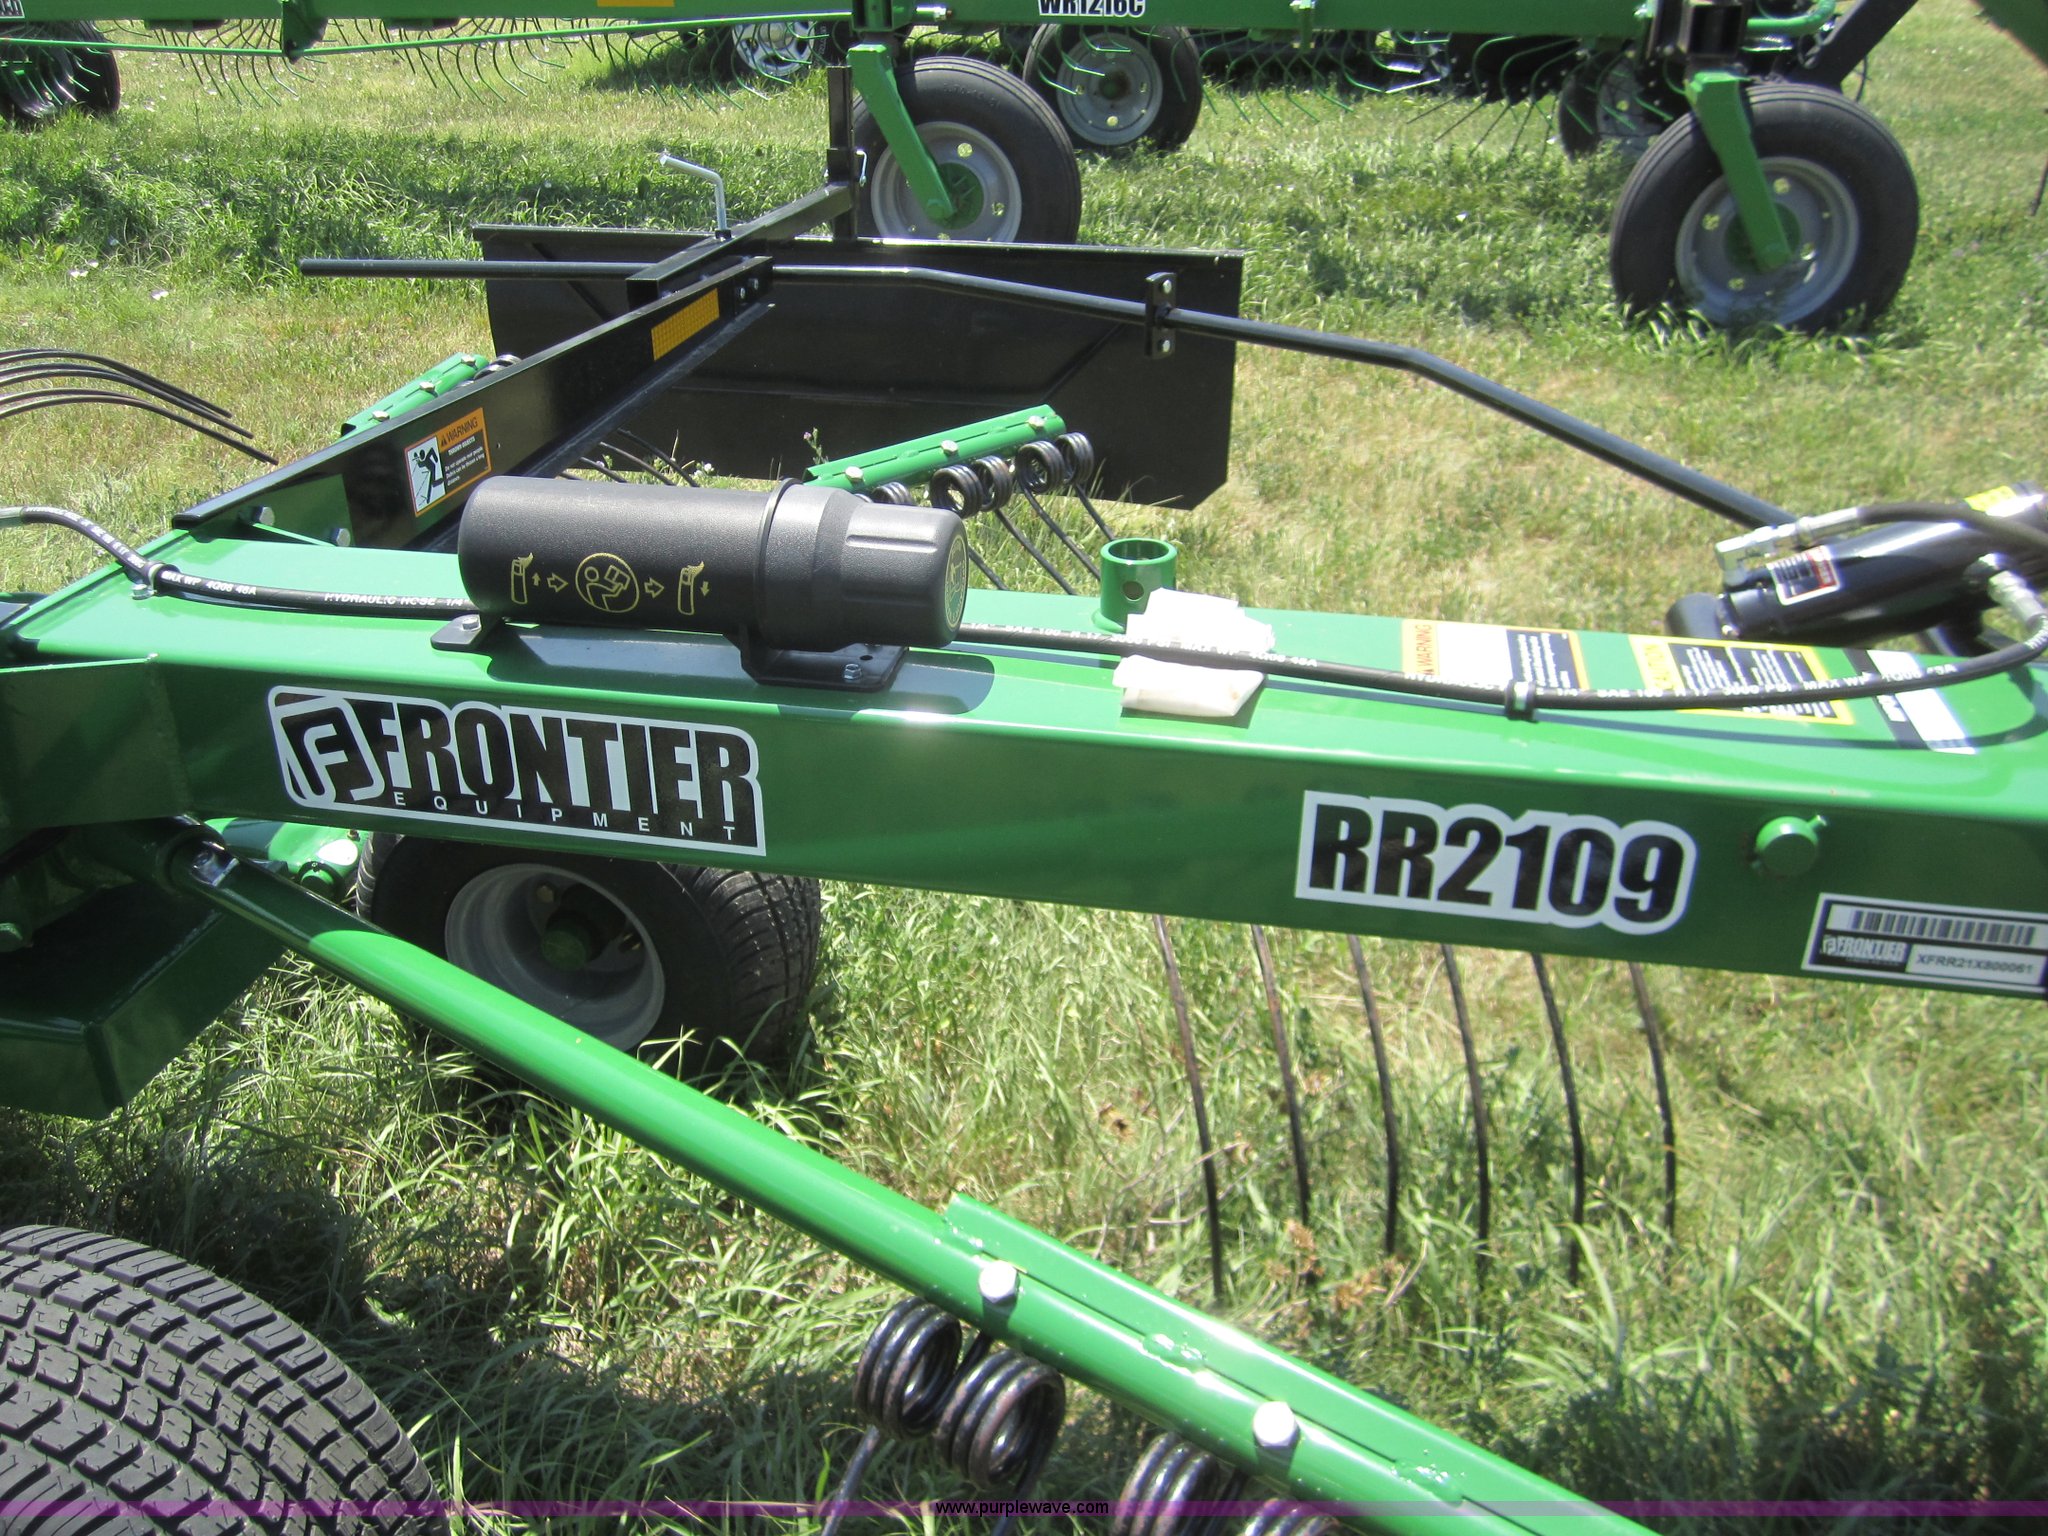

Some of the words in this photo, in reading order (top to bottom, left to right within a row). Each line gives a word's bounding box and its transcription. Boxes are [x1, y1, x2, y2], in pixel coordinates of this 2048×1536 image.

[1040, 0, 1144, 16] WR1216C
[447, 416, 479, 442] WARNING
[1415, 624, 1434, 672] WARNING
[343, 697, 758, 824] FRONTIER
[393, 791, 737, 841] EQUIPMENT
[1308, 803, 1685, 924] RR2109
